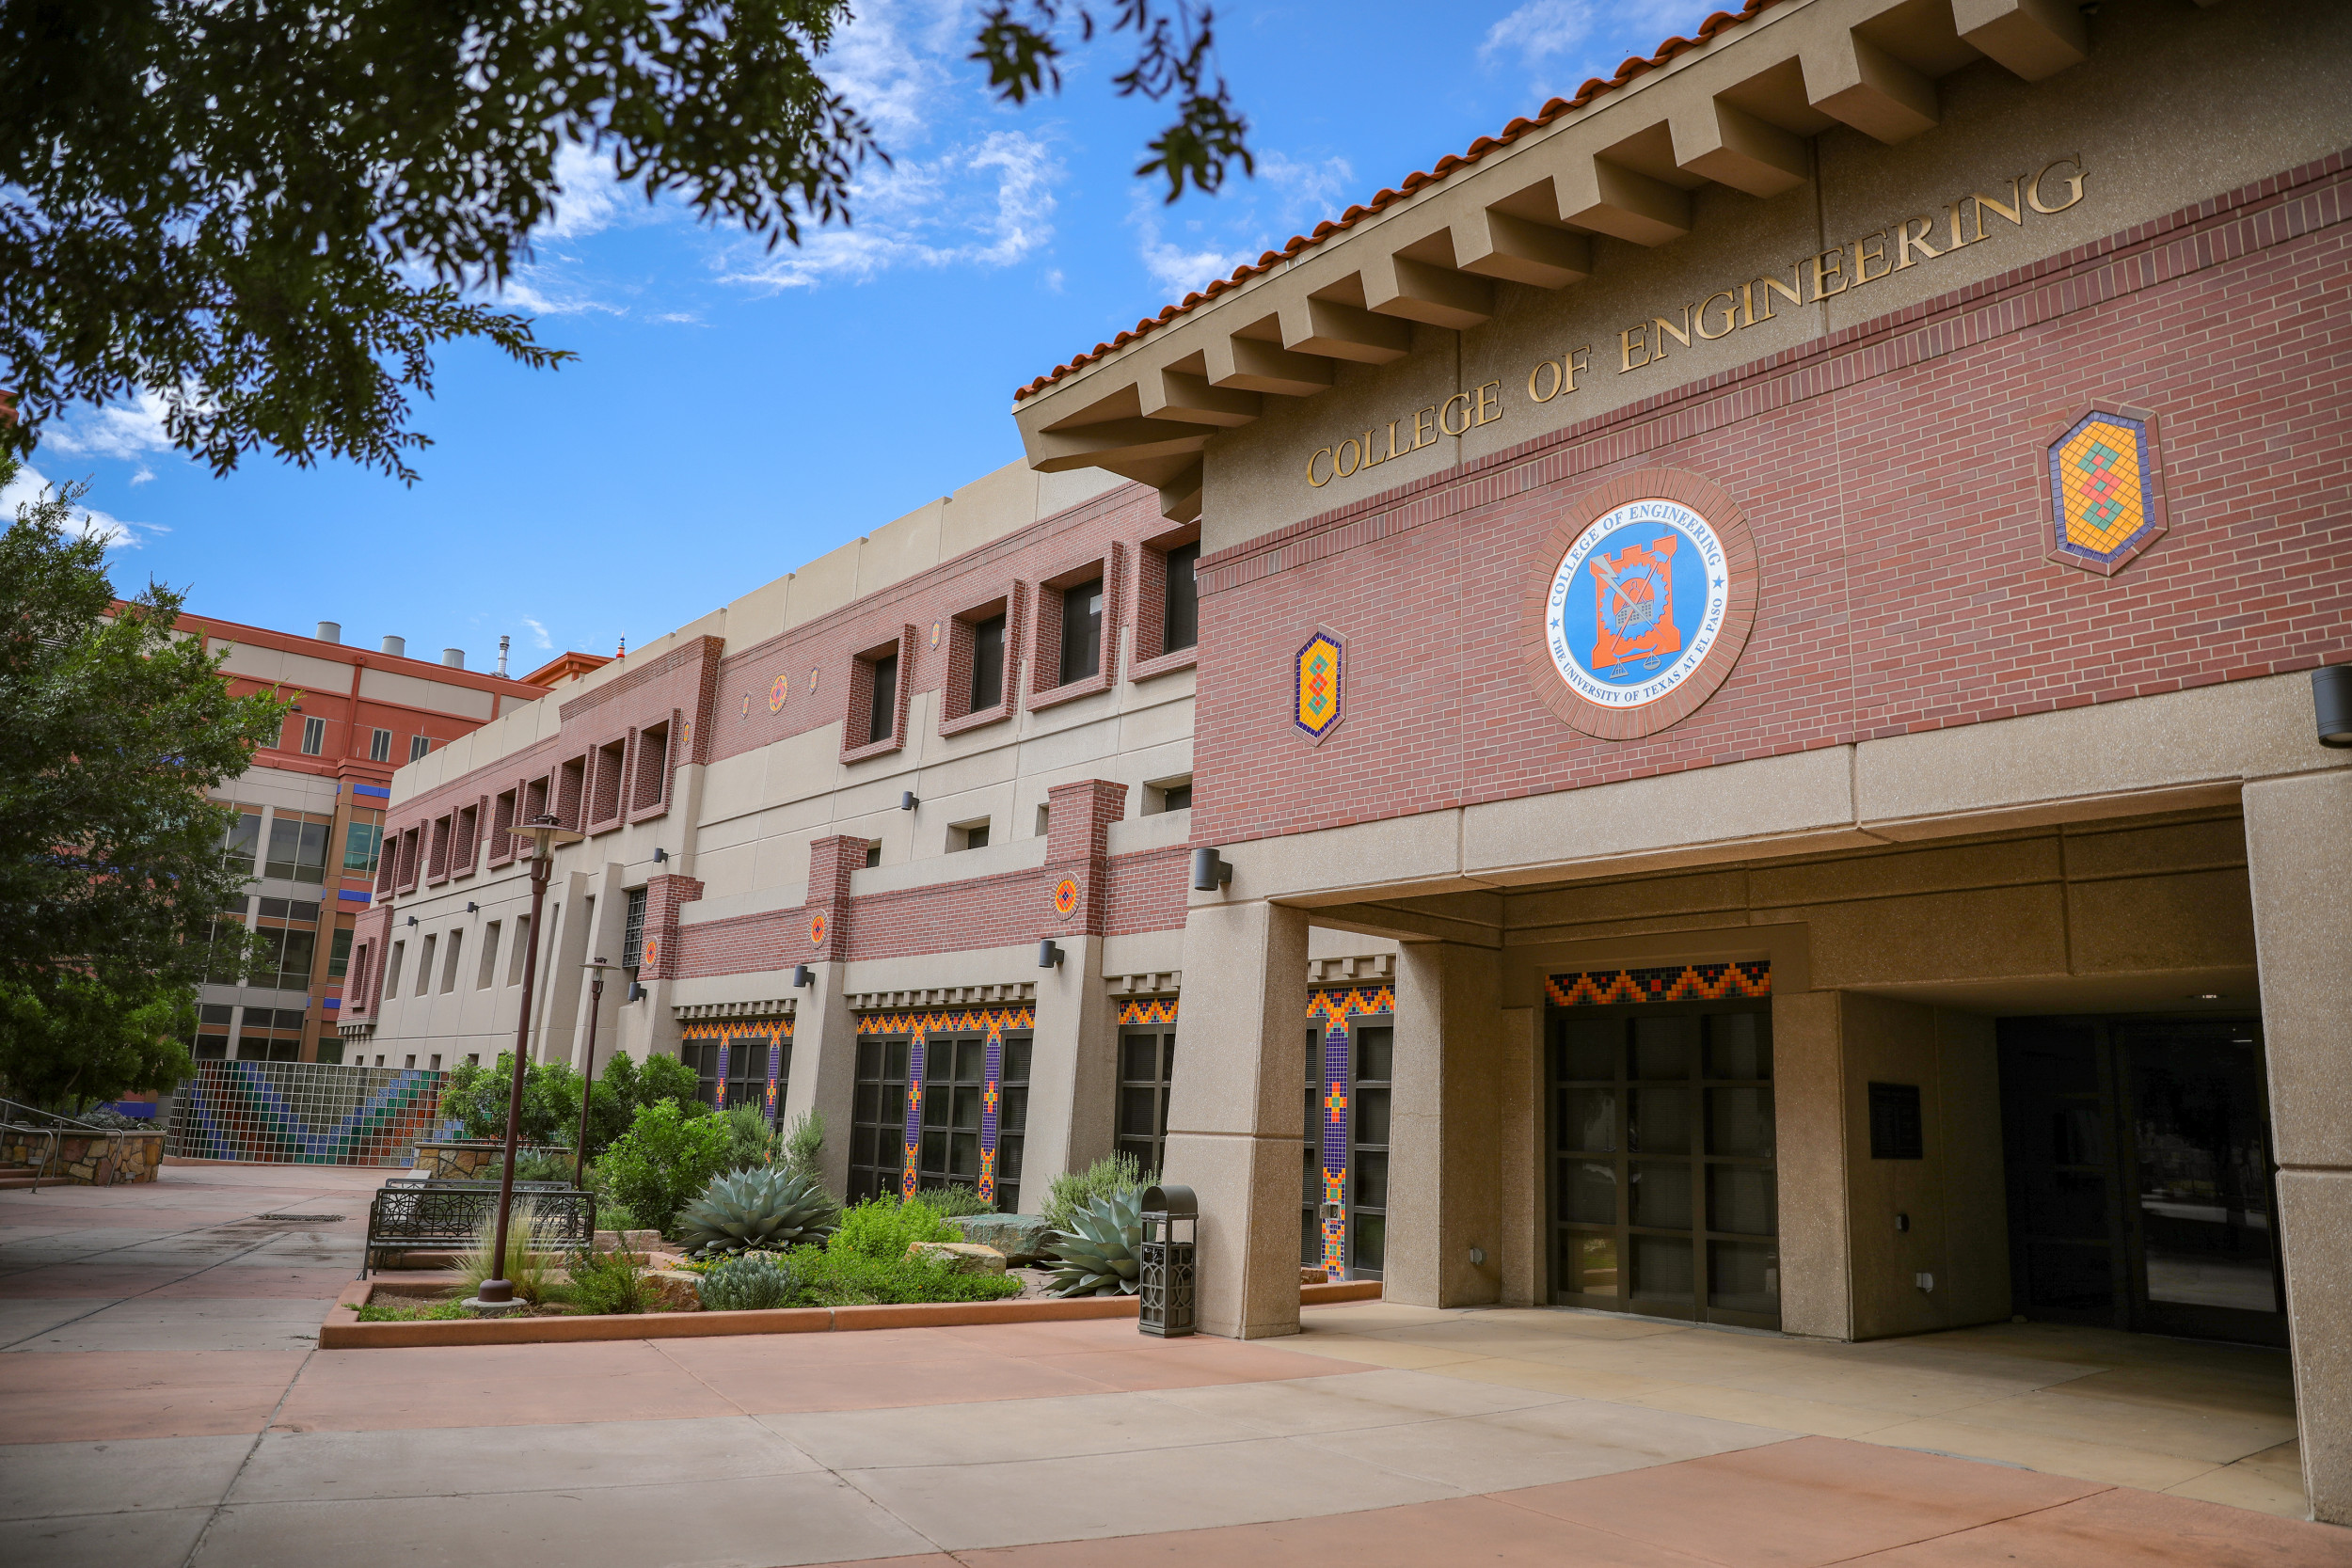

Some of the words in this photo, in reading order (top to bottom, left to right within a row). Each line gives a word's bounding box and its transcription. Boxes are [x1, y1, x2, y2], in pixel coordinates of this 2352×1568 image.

[1307, 379, 1504, 487] COLLEGE
[1528, 344, 1592, 404] OF
[1617, 152, 2090, 374] ENGINEERING
[1551, 529, 1599, 607] COLLEGE
[1603, 511, 1624, 531] OF
[1629, 504, 1722, 566] ENGINEERING
[1552, 637, 1566, 662] THE
[1563, 662, 1620, 702] UNIVERSITY
[1624, 690, 1640, 702] OF
[1643, 671, 1681, 698] TEXAS
[1684, 655, 1695, 673] AT
[1694, 637, 1710, 655] EL
[1706, 598, 1723, 633] PASO
